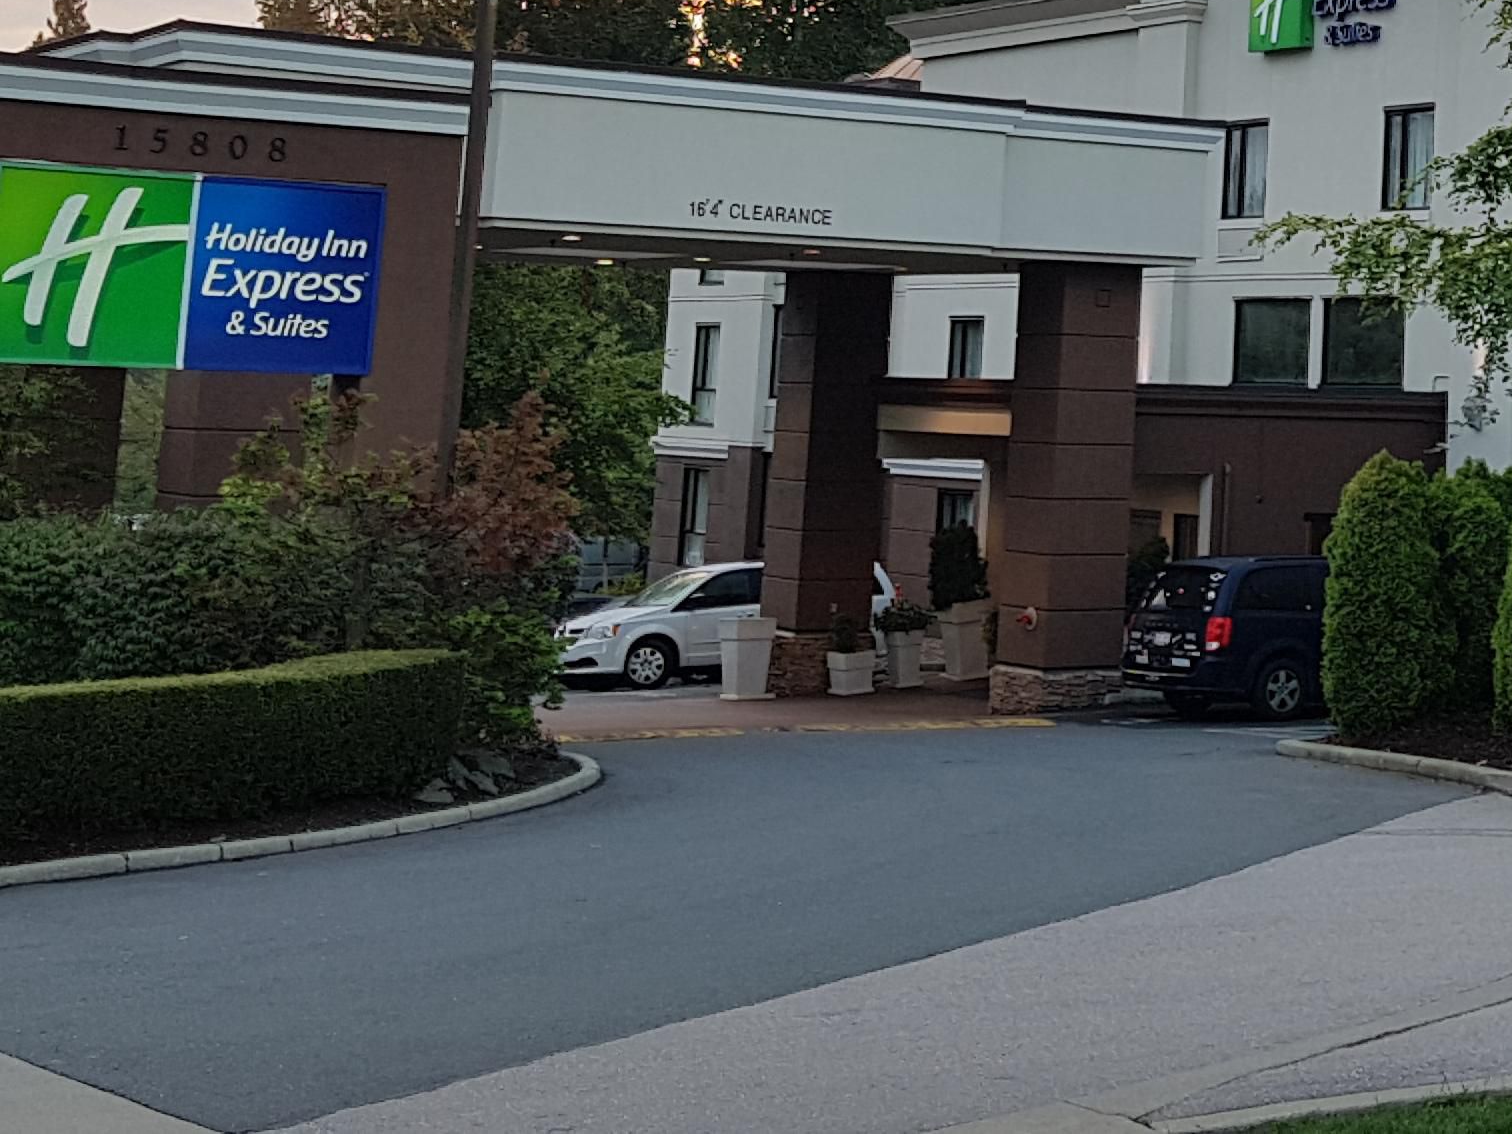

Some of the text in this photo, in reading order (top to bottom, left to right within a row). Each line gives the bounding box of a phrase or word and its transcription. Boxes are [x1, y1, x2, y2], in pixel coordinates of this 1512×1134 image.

[114, 124, 287, 163] 15808
[729, 203, 833, 226] CLEARANCE
[204, 221, 369, 263] Holiday Inn
[201, 257, 367, 309] Express
[225, 310, 330, 339] & Suites
